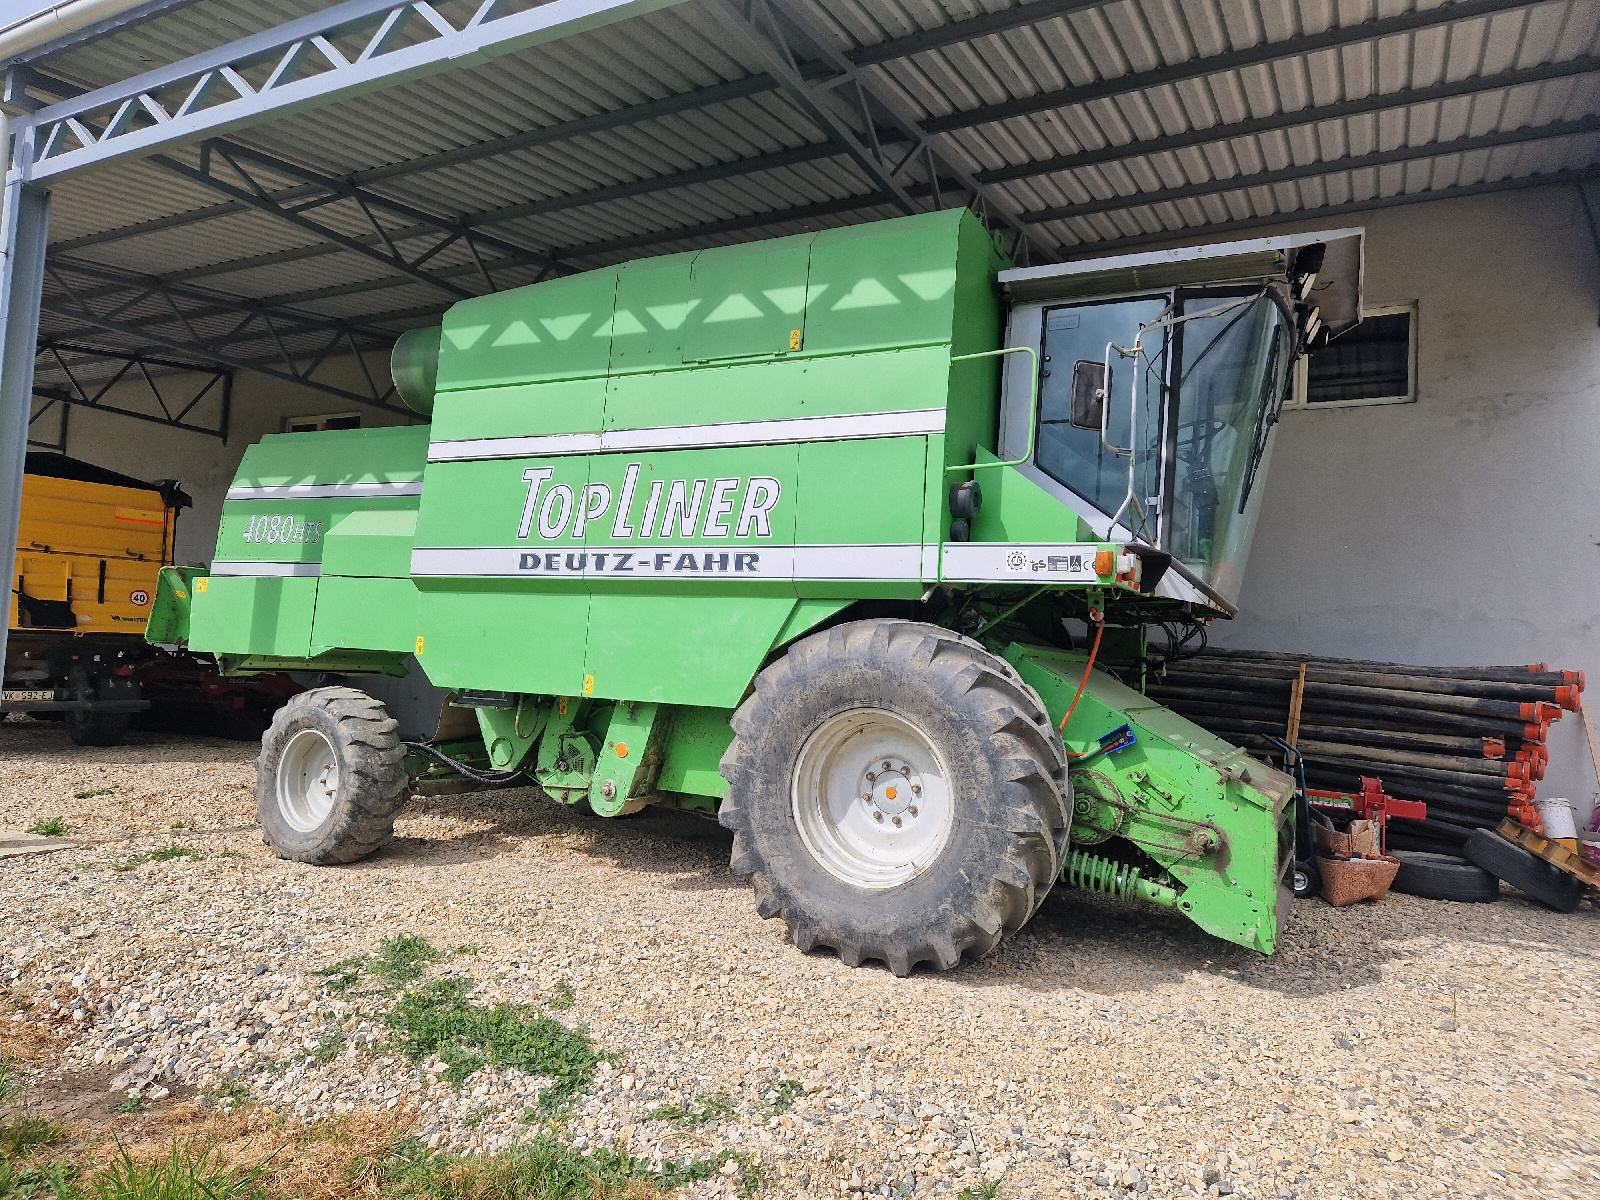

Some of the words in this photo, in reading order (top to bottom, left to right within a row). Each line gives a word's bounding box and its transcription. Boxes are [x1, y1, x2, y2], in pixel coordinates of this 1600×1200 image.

[518, 552, 761, 572] DEUTZ-FAHR
[133, 594, 146, 602] 40
[3, 691, 14, 700] VK
